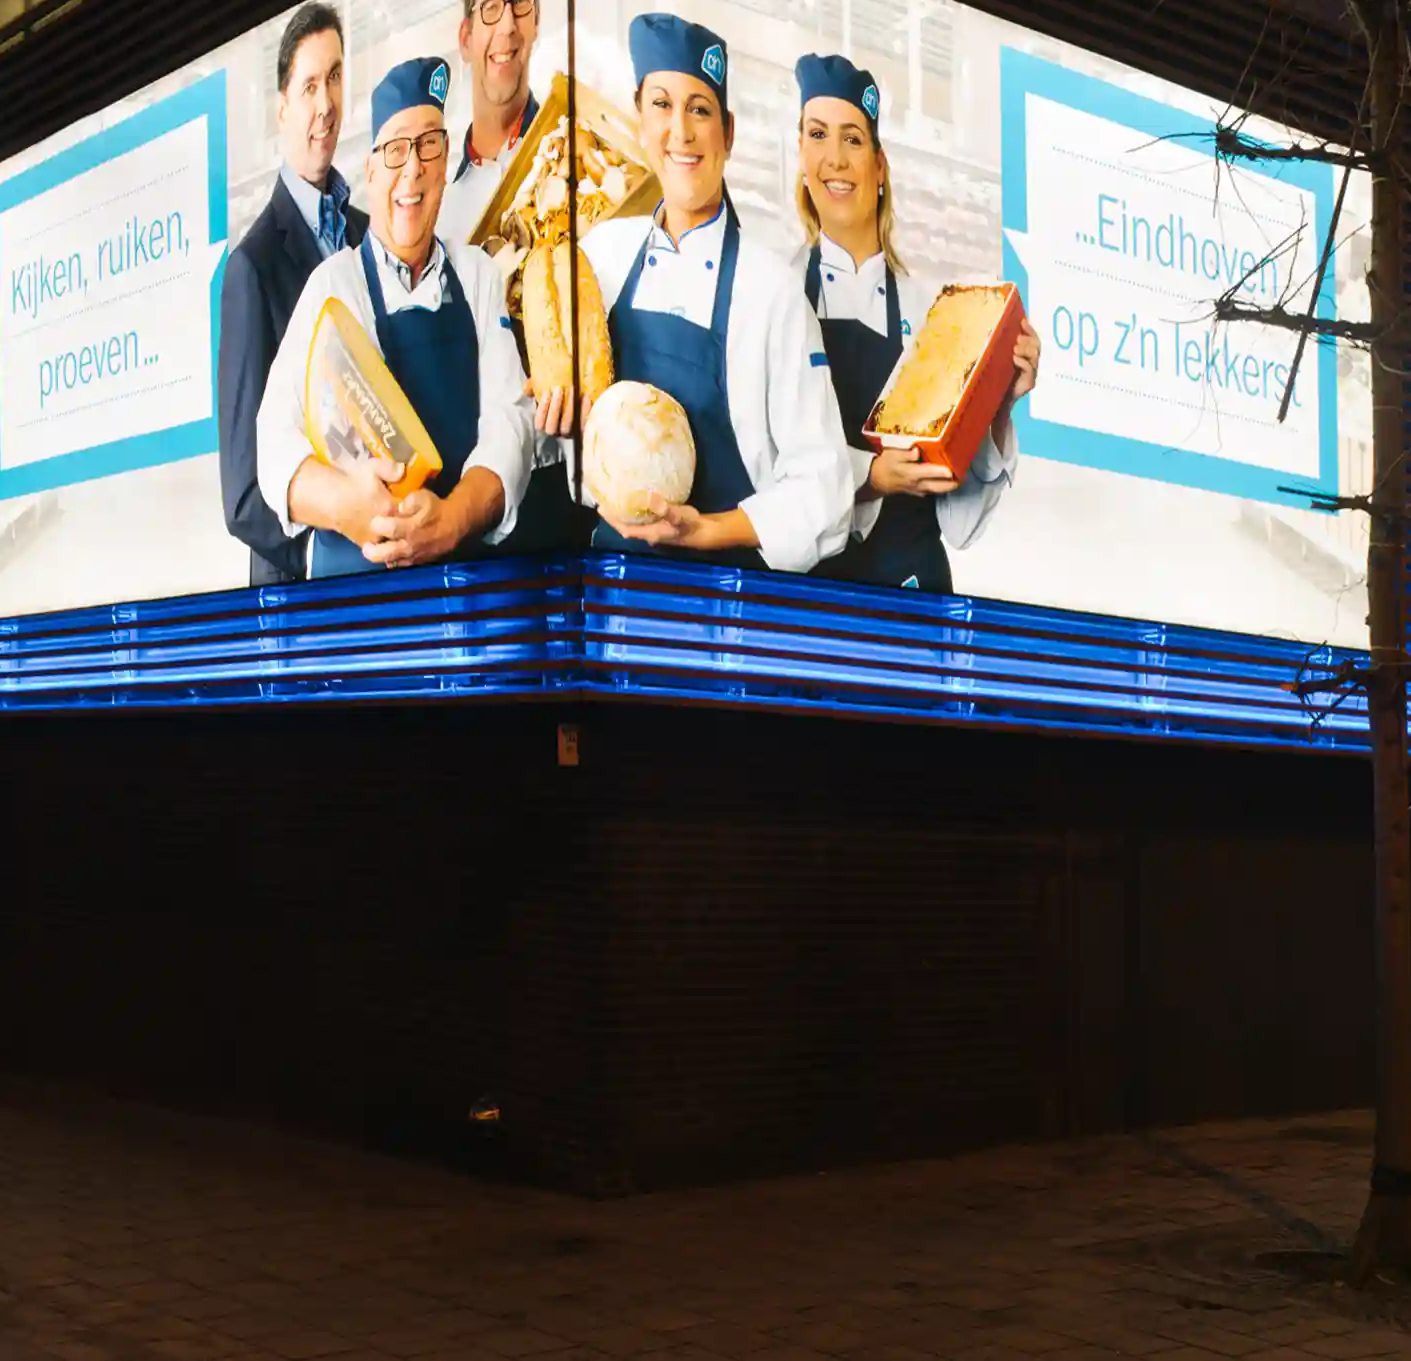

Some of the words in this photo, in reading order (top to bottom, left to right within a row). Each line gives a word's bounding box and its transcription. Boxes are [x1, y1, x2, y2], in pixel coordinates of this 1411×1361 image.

[11, 251, 89, 319] Kijken,
[96, 209, 189, 288] ruiken,
[38, 330, 160, 409] proeven...
[1052, 305, 1099, 367] op
[1113, 313, 1160, 372] z'n
